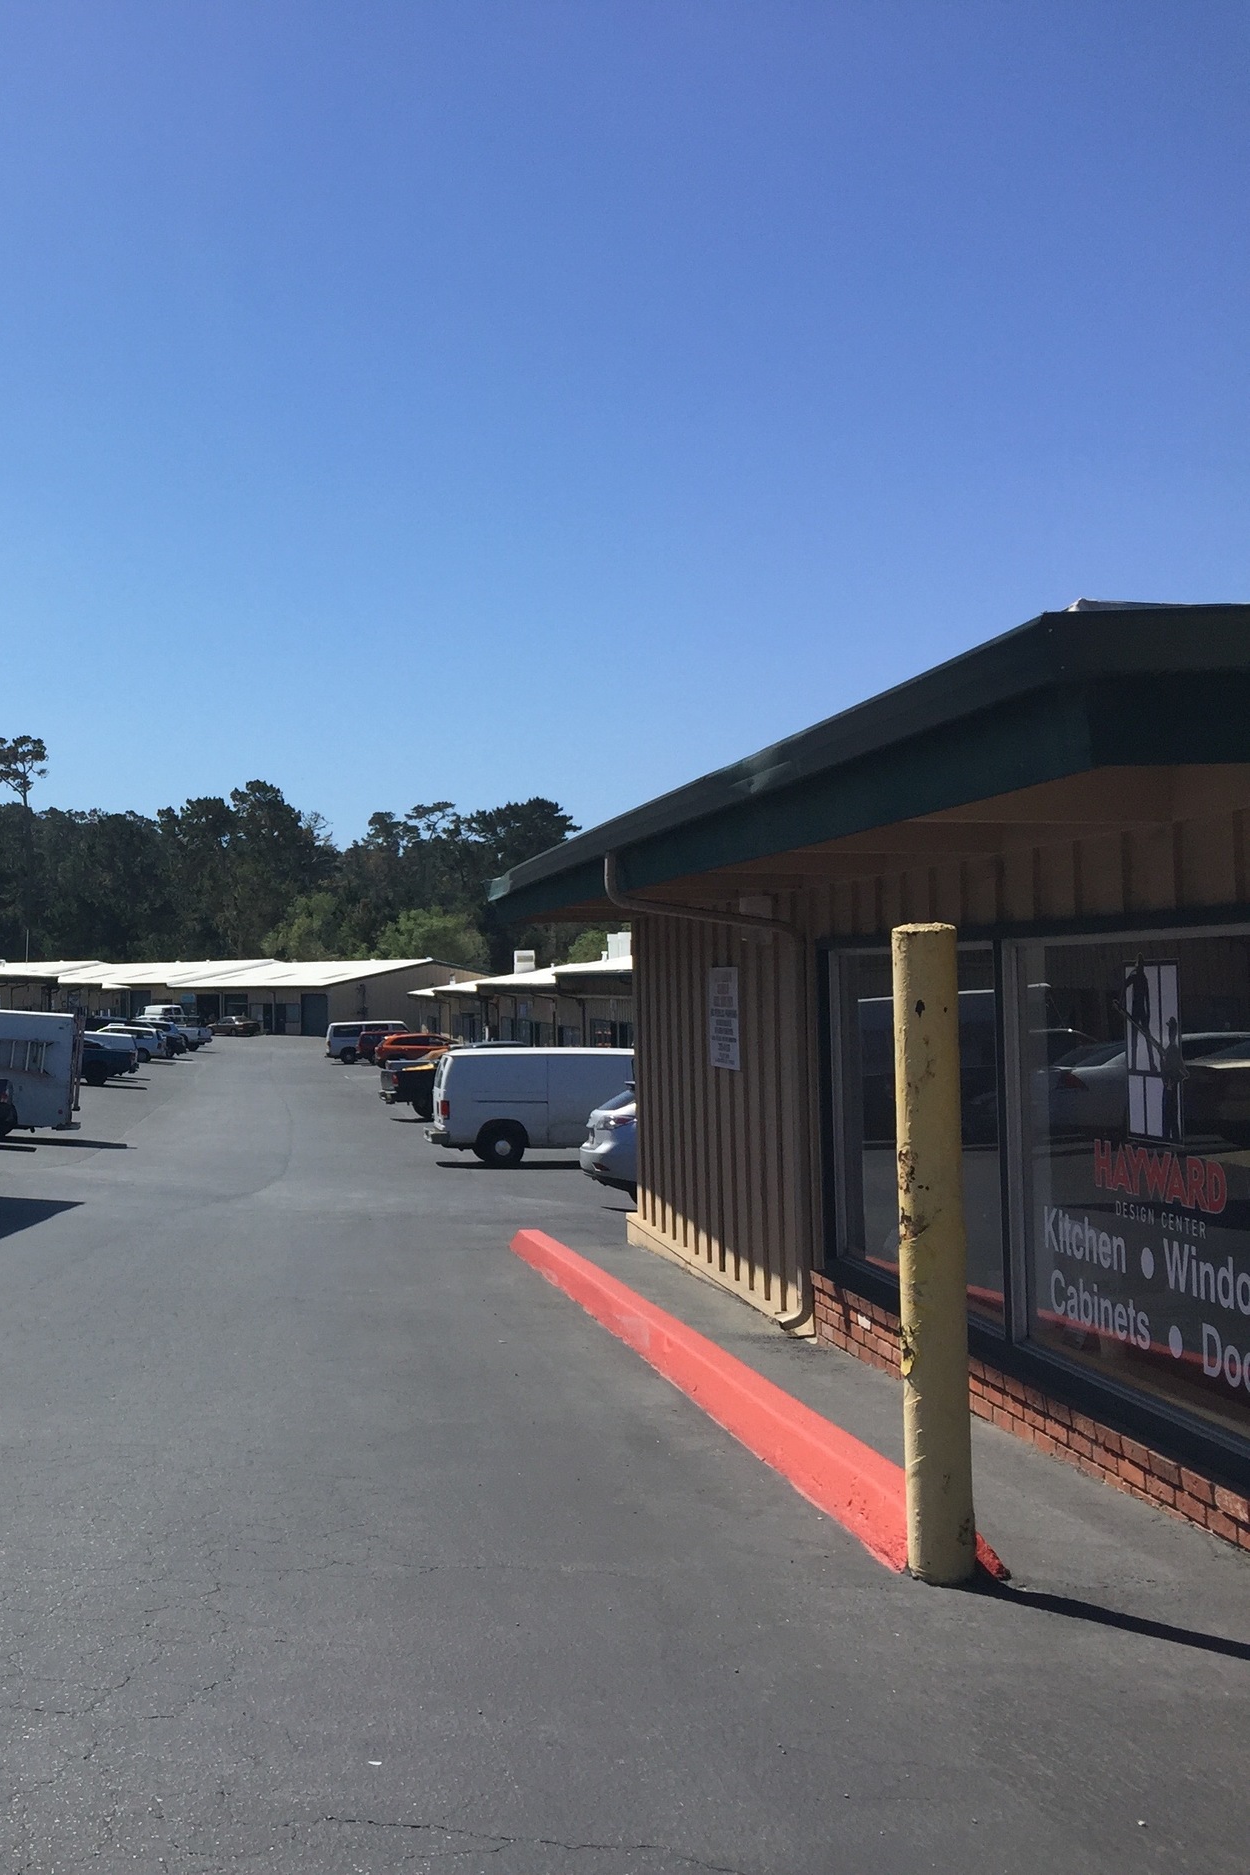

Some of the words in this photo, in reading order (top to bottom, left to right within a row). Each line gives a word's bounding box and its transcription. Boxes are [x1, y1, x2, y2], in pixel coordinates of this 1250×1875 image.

[1094, 1139, 1228, 1214] HAYWARD
[1043, 1205, 1127, 1274] Kitchen
[1115, 1200, 1155, 1225] DESIGN
[1161, 1212, 1206, 1239] CENTER
[1050, 1269, 1151, 1350] Cabinets
